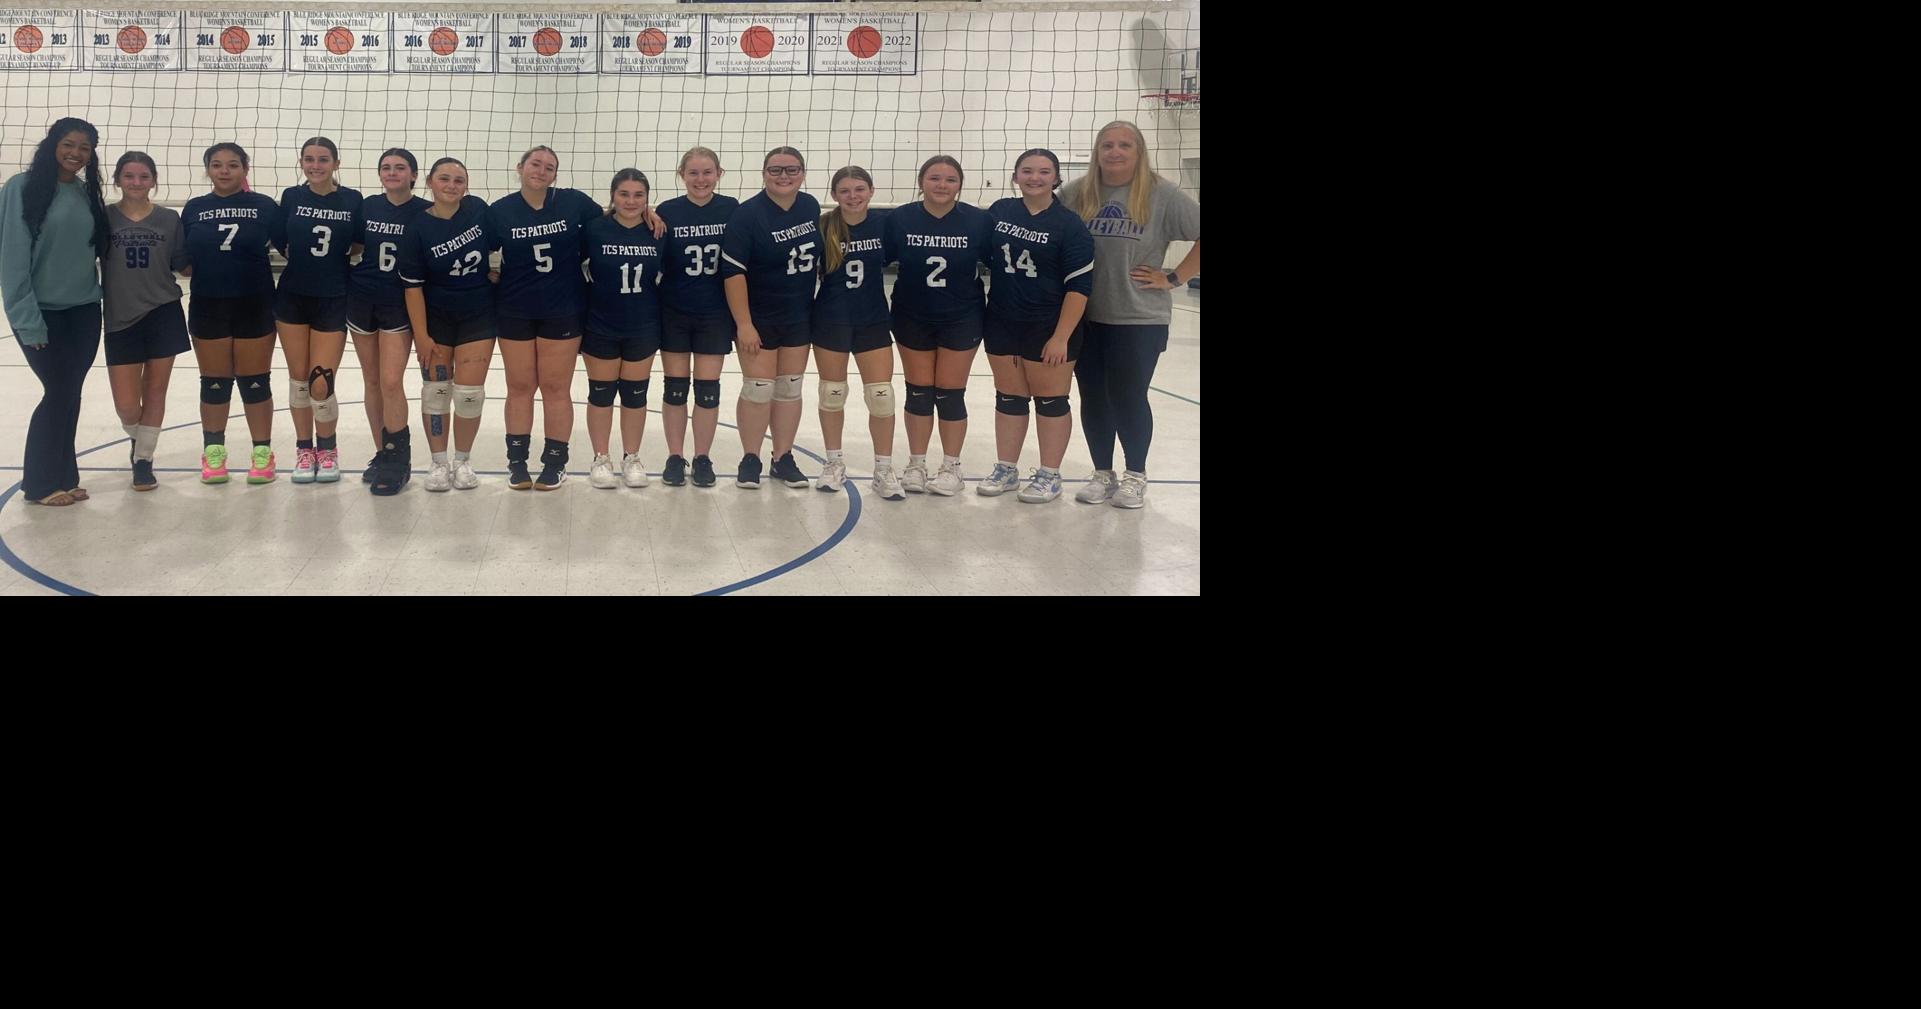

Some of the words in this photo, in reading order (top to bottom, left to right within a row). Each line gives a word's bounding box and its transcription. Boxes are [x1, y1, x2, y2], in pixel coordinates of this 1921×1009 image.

[440, 19, 472, 27] BASKETBALL
[51, 33, 67, 45] 2013
[94, 34, 110, 45] 2013
[154, 34, 170, 45] 2014
[196, 34, 214, 46] 2014
[257, 34, 275, 46] 2015
[301, 34, 319, 46] 2015
[362, 35, 379, 47] 2016
[404, 35, 422, 47] 2016
[466, 36, 484, 48] 2017
[509, 36, 527, 48] 2017
[570, 36, 588, 48] 2018
[612, 36, 631, 48] 2018
[674, 36, 692, 48] 2019
[711, 36, 737, 46] 2019
[777, 36, 805, 46] 2020
[817, 36, 842, 46] 2021
[884, 36, 911, 46] 2022
[199, 210, 214, 221] TCS
[215, 208, 258, 219] PATRIOTS
[296, 206, 312, 218] TCS
[312, 208, 352, 222] PATRIOTS
[511, 227, 527, 239] TCS
[528, 220, 567, 238] PATRIOTS
[673, 226, 689, 238] TCS
[690, 223, 727, 237] PATRIOT
[771, 230, 788, 243] TCS
[786, 220, 817, 240] PATRIOTS
[994, 220, 1011, 233] TCS
[1008, 224, 1049, 244] PATRIOTS
[218, 223, 239, 251] 7
[310, 225, 332, 257] 3
[431, 242, 448, 258] TCS
[447, 225, 482, 252] PATRIOTS
[906, 234, 922, 246] TCS
[923, 235, 968, 249] PATRIOTS
[125, 246, 150, 269] 99
[379, 241, 397, 272] 6
[533, 242, 553, 273] 5
[602, 245, 618, 255] TCS
[619, 245, 657, 257] PATRIOTS
[449, 250, 482, 276] 12
[684, 244, 721, 276] 33
[786, 241, 816, 275] 15
[1001, 242, 1037, 278] 14
[620, 262, 643, 294] 11
[845, 259, 864, 289] 9
[926, 255, 947, 288] 2
